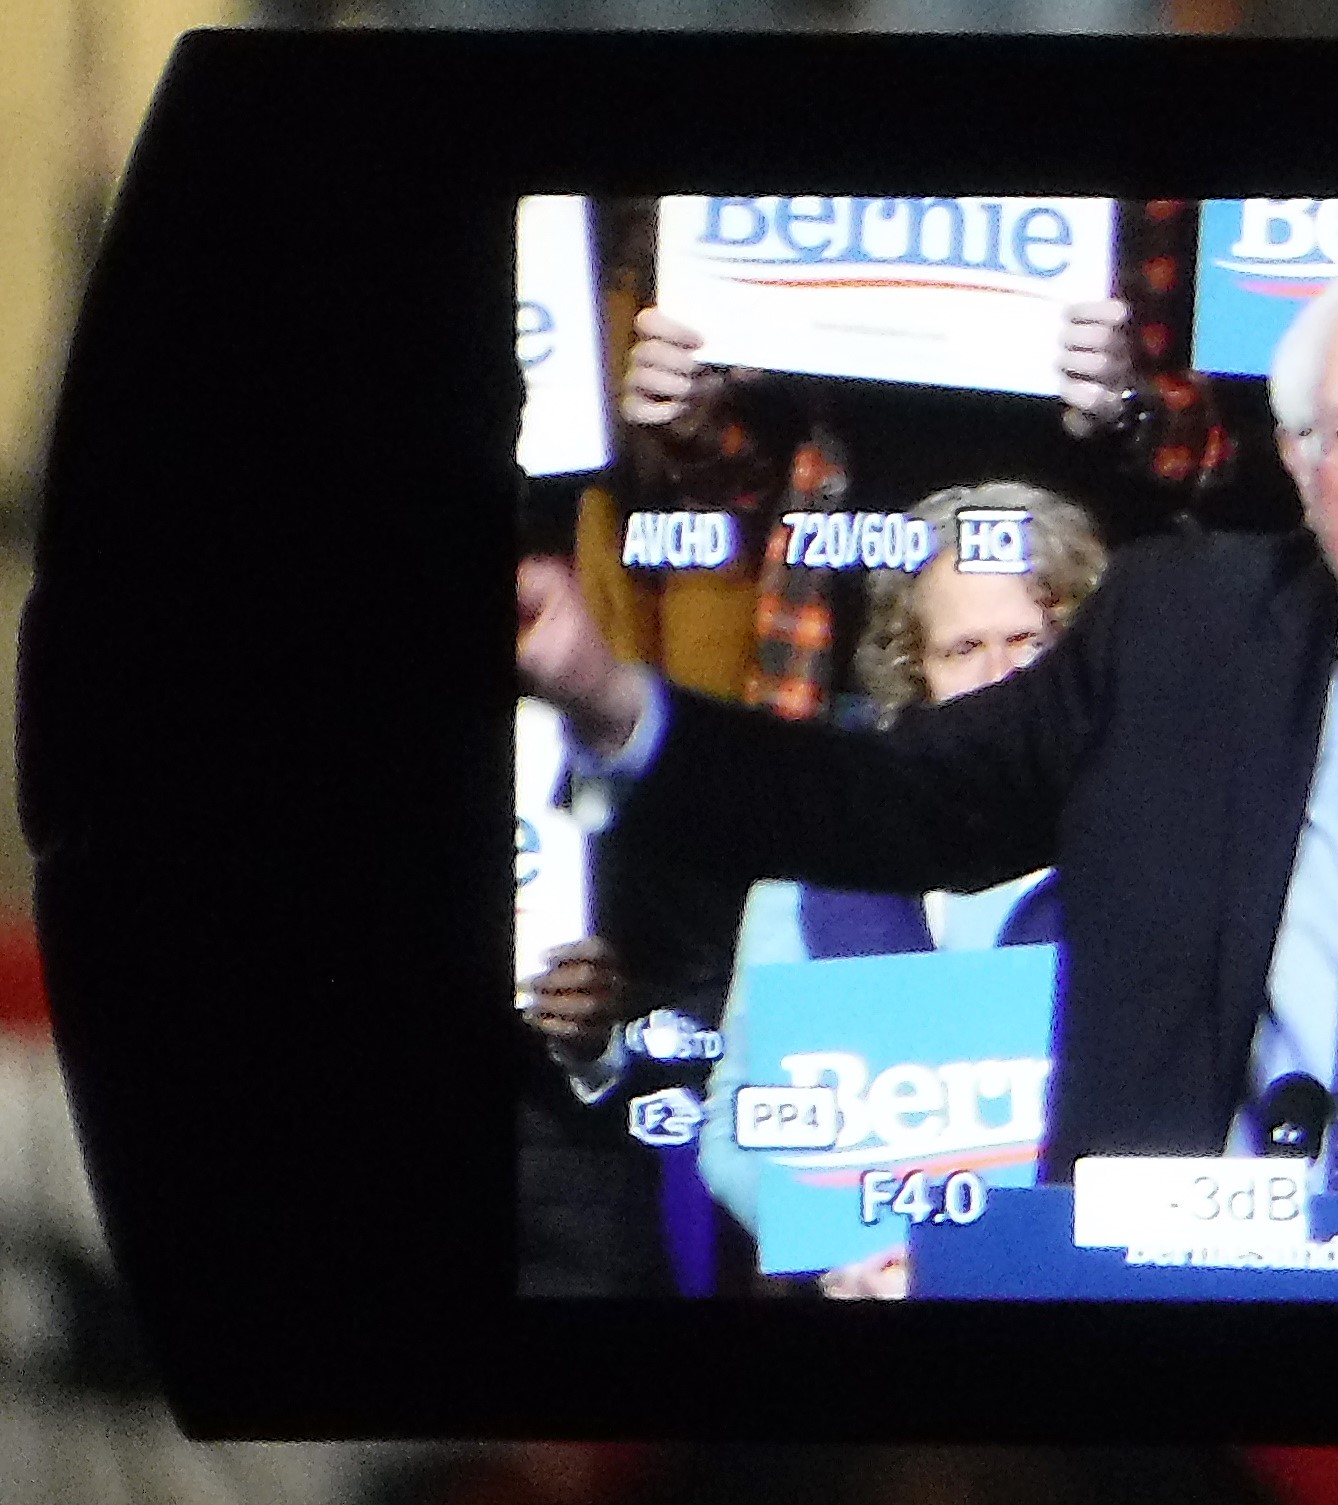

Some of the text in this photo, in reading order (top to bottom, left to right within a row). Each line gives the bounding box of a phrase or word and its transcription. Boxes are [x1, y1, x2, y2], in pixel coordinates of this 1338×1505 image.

[698, 198, 1073, 278] Bernie
[623, 511, 1029, 572] AVCHD 720/60p HQ
[862, 1170, 986, 1225] F4.0
[1168, 1175, 1300, 1223] -3dB
